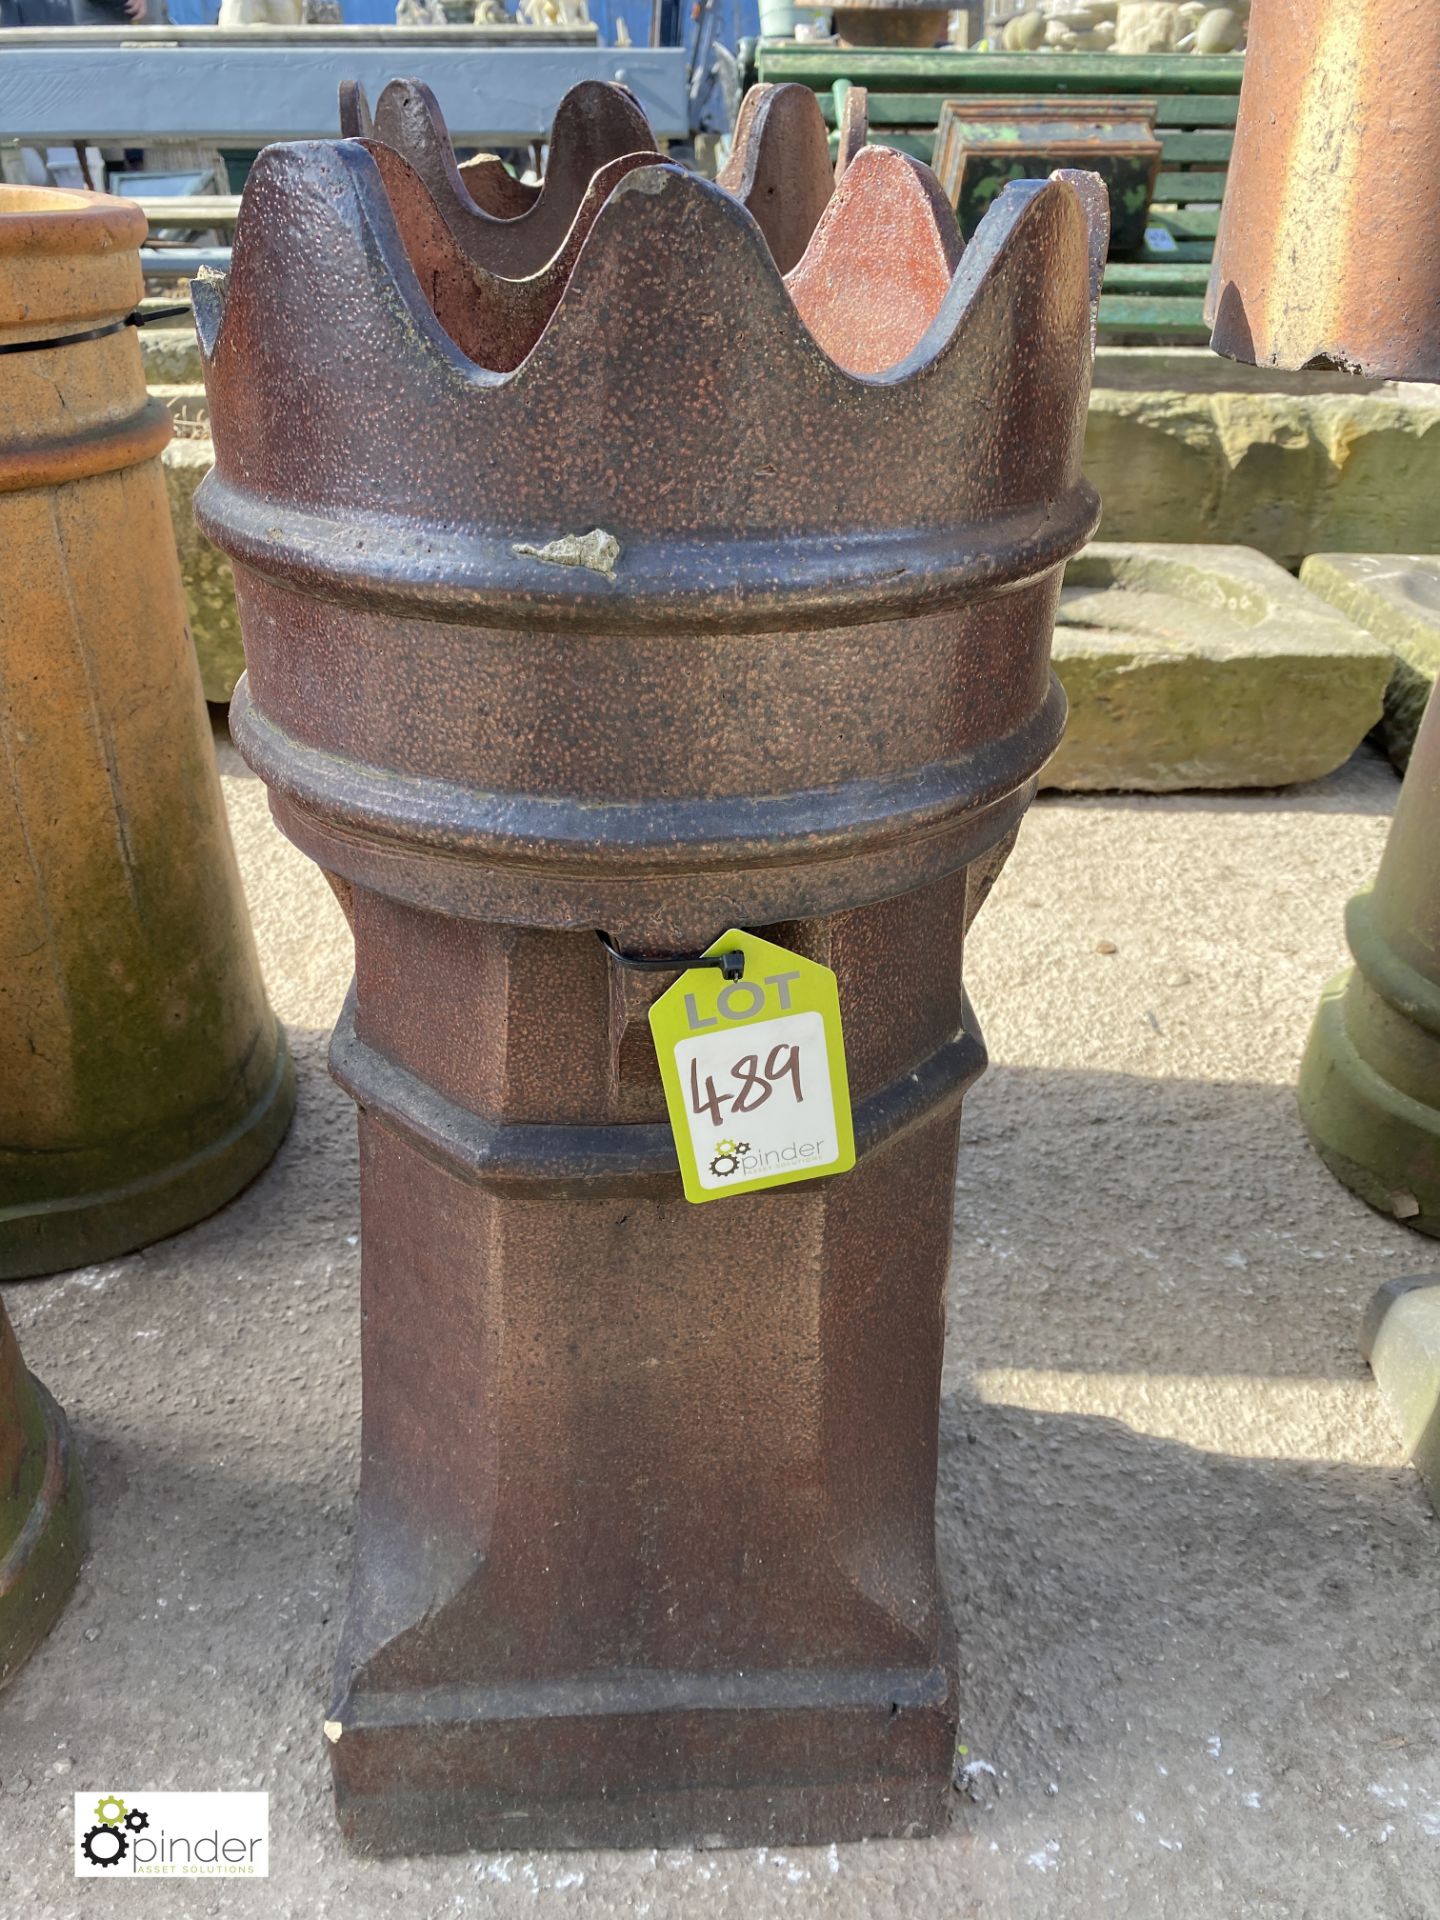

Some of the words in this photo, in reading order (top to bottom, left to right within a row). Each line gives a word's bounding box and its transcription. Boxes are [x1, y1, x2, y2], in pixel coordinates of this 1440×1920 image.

[683, 971, 801, 1030] LOT
[690, 1044, 804, 1127] 489
[741, 1140, 825, 1176] pinder
